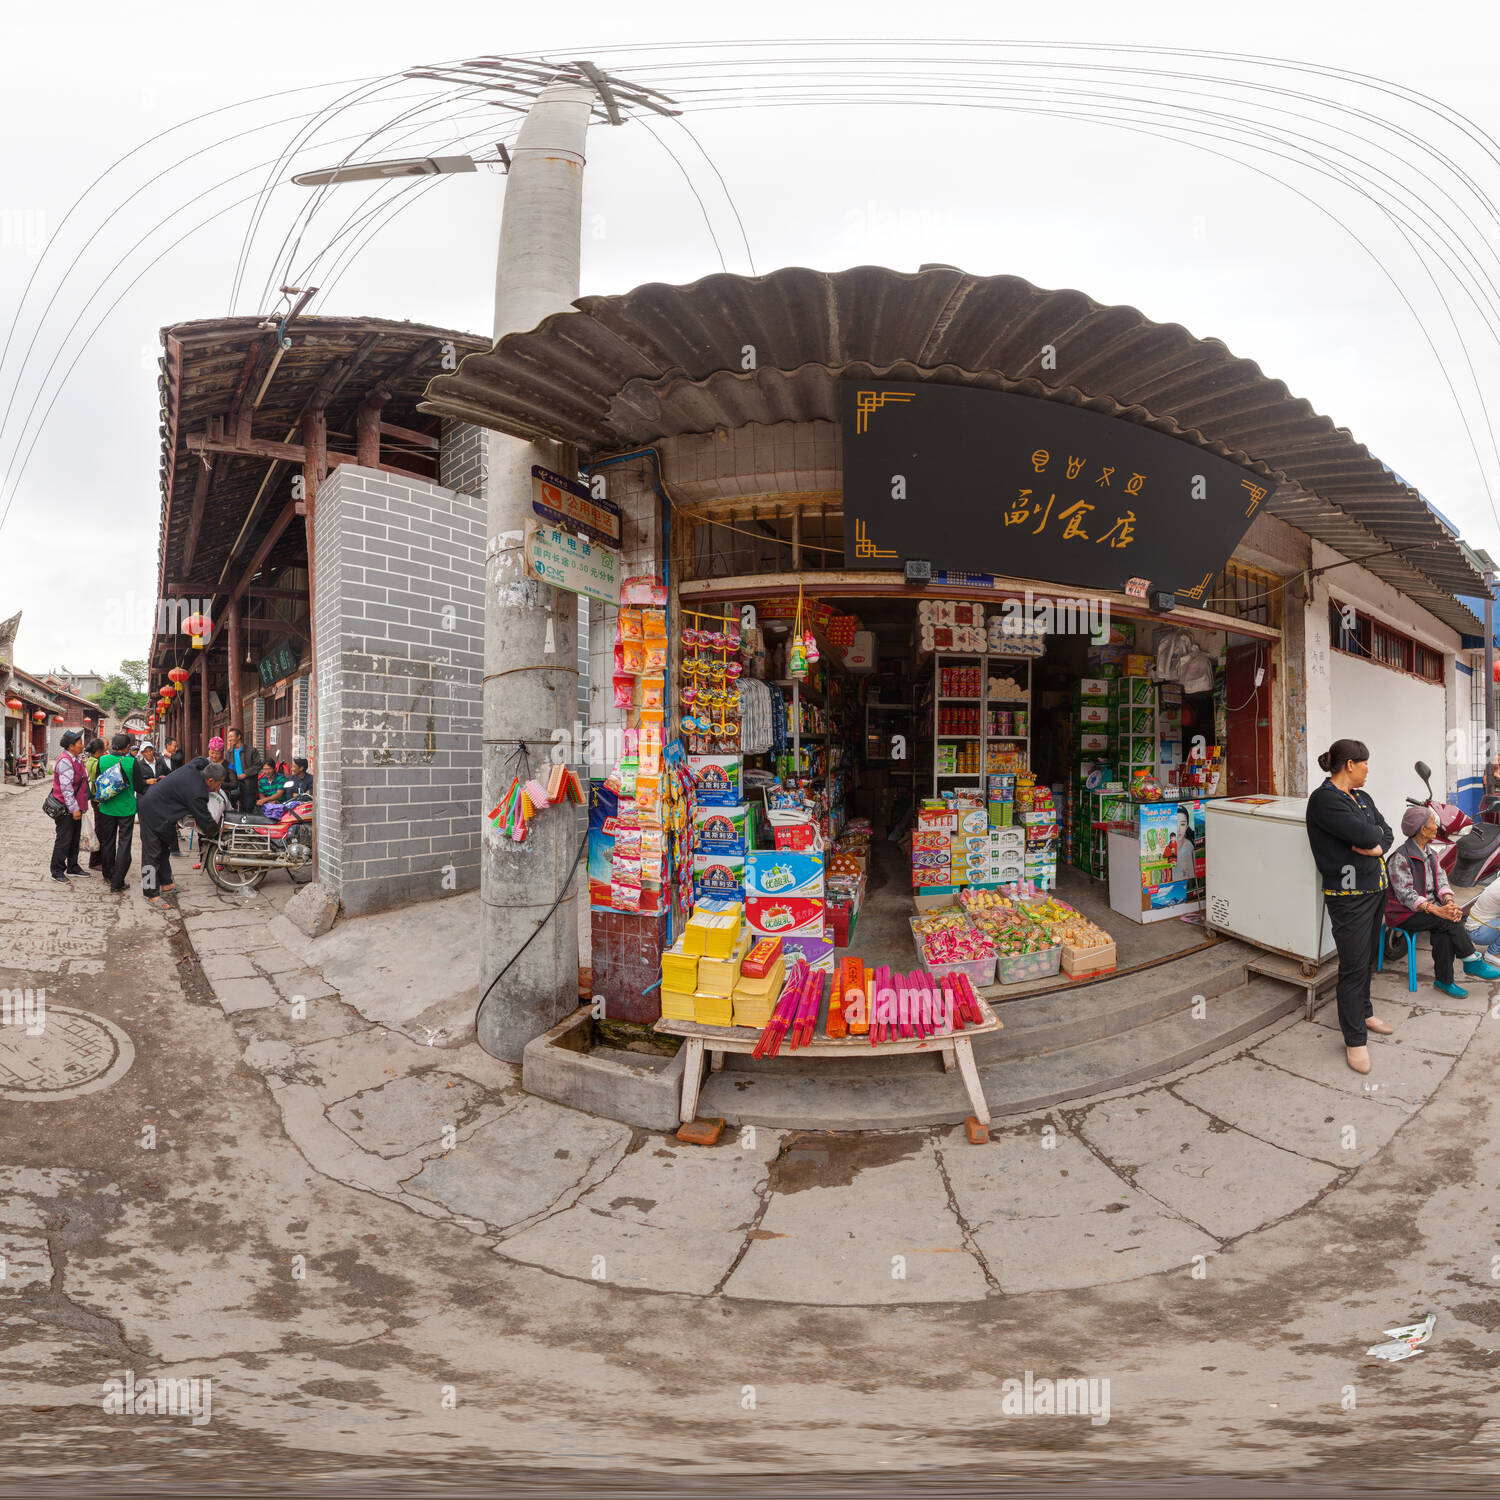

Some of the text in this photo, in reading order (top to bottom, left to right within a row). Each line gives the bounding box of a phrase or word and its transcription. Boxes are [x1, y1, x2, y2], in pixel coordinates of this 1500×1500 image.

[567, 495, 613, 528] 公用电话
[1004, 488, 1137, 550] 副食店
[536, 526, 591, 557] 公用电话
[704, 832, 734, 840] 莫斯利安
